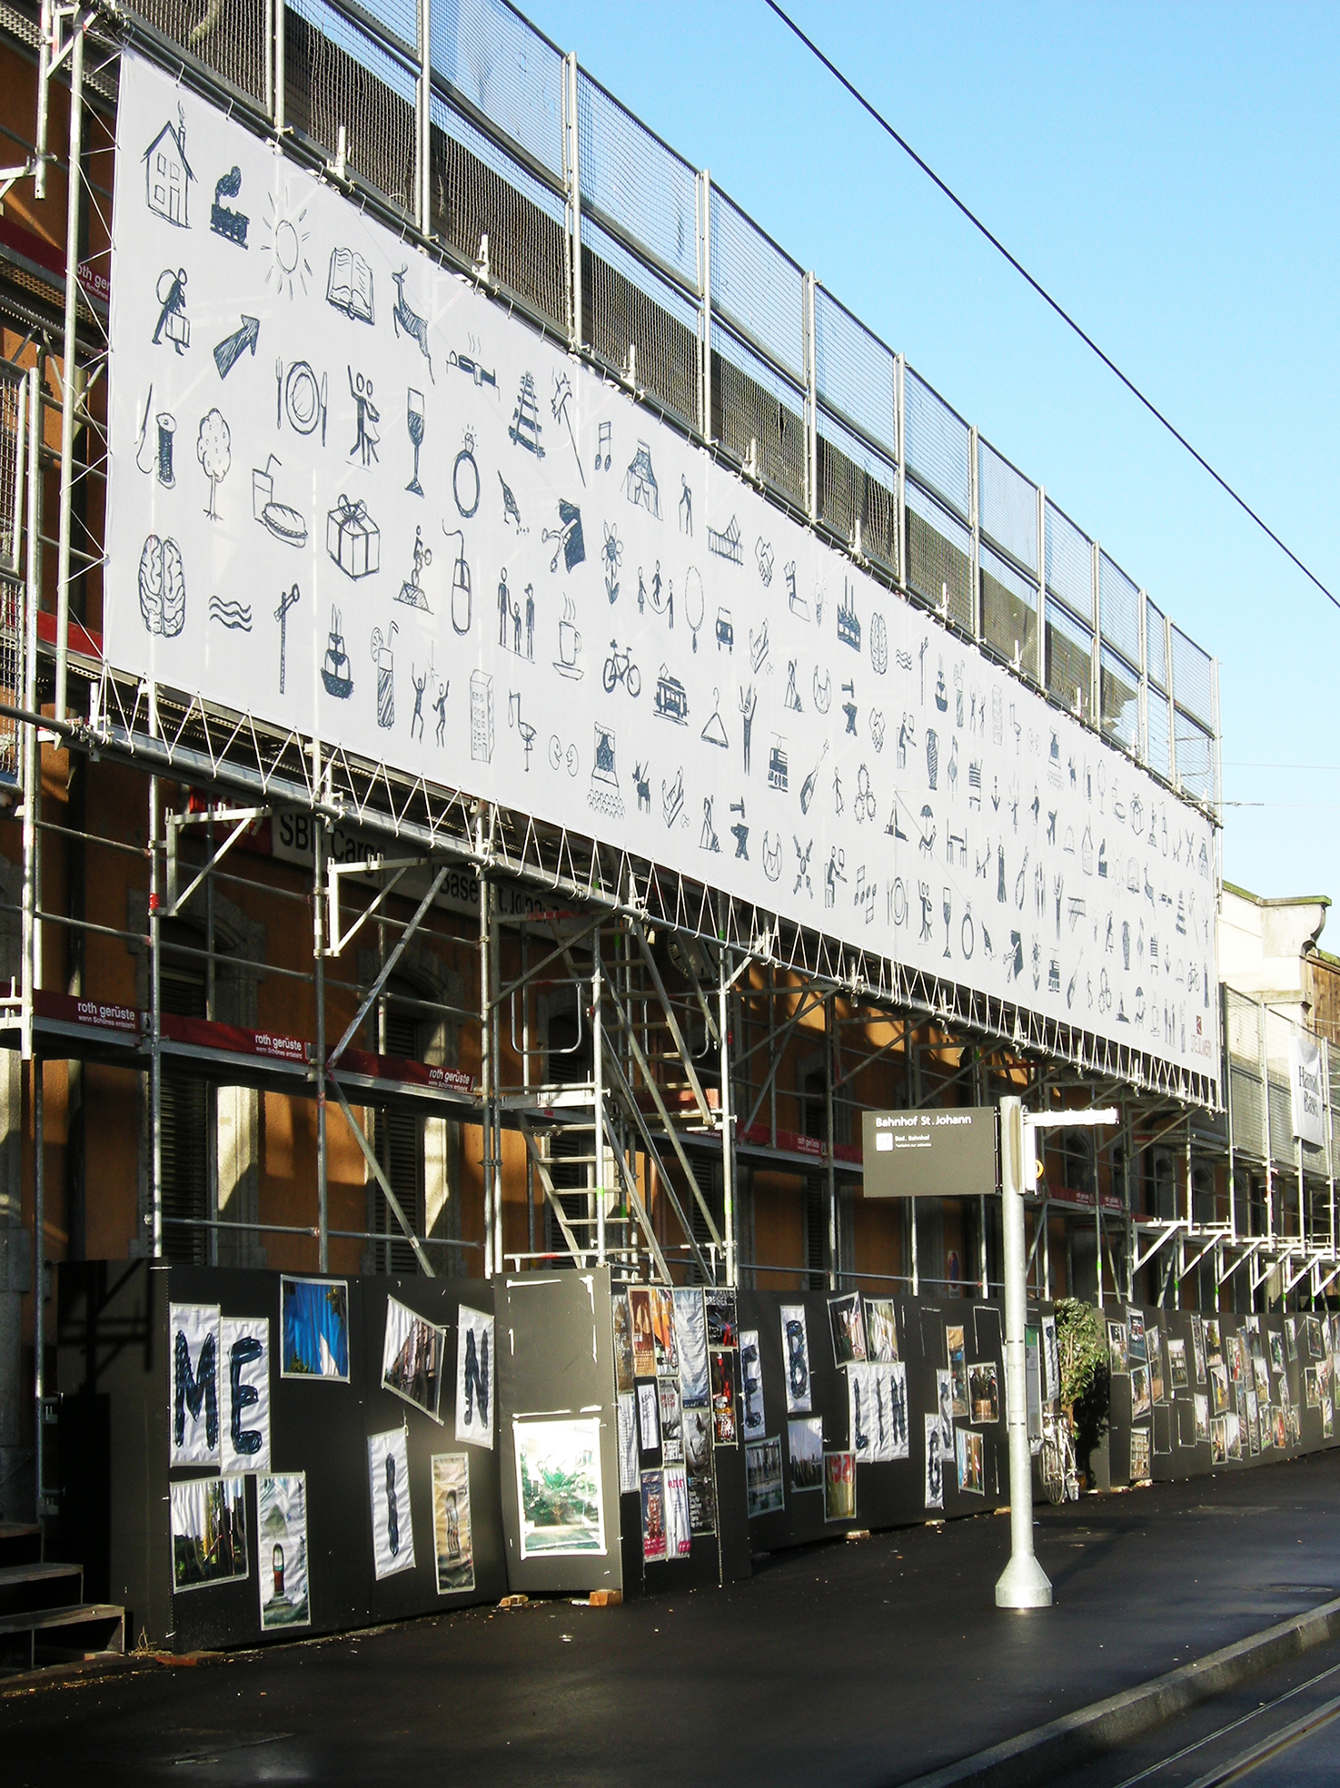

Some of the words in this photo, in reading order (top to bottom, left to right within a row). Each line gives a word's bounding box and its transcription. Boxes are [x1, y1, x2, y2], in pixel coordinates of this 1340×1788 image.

[76, 263, 92, 281] oth
[77, 1002, 97, 1014] roth
[99, 1006, 135, 1020] gerüste
[255, 1034, 271, 1046] roth
[875, 1116, 918, 1128] Bahnhof
